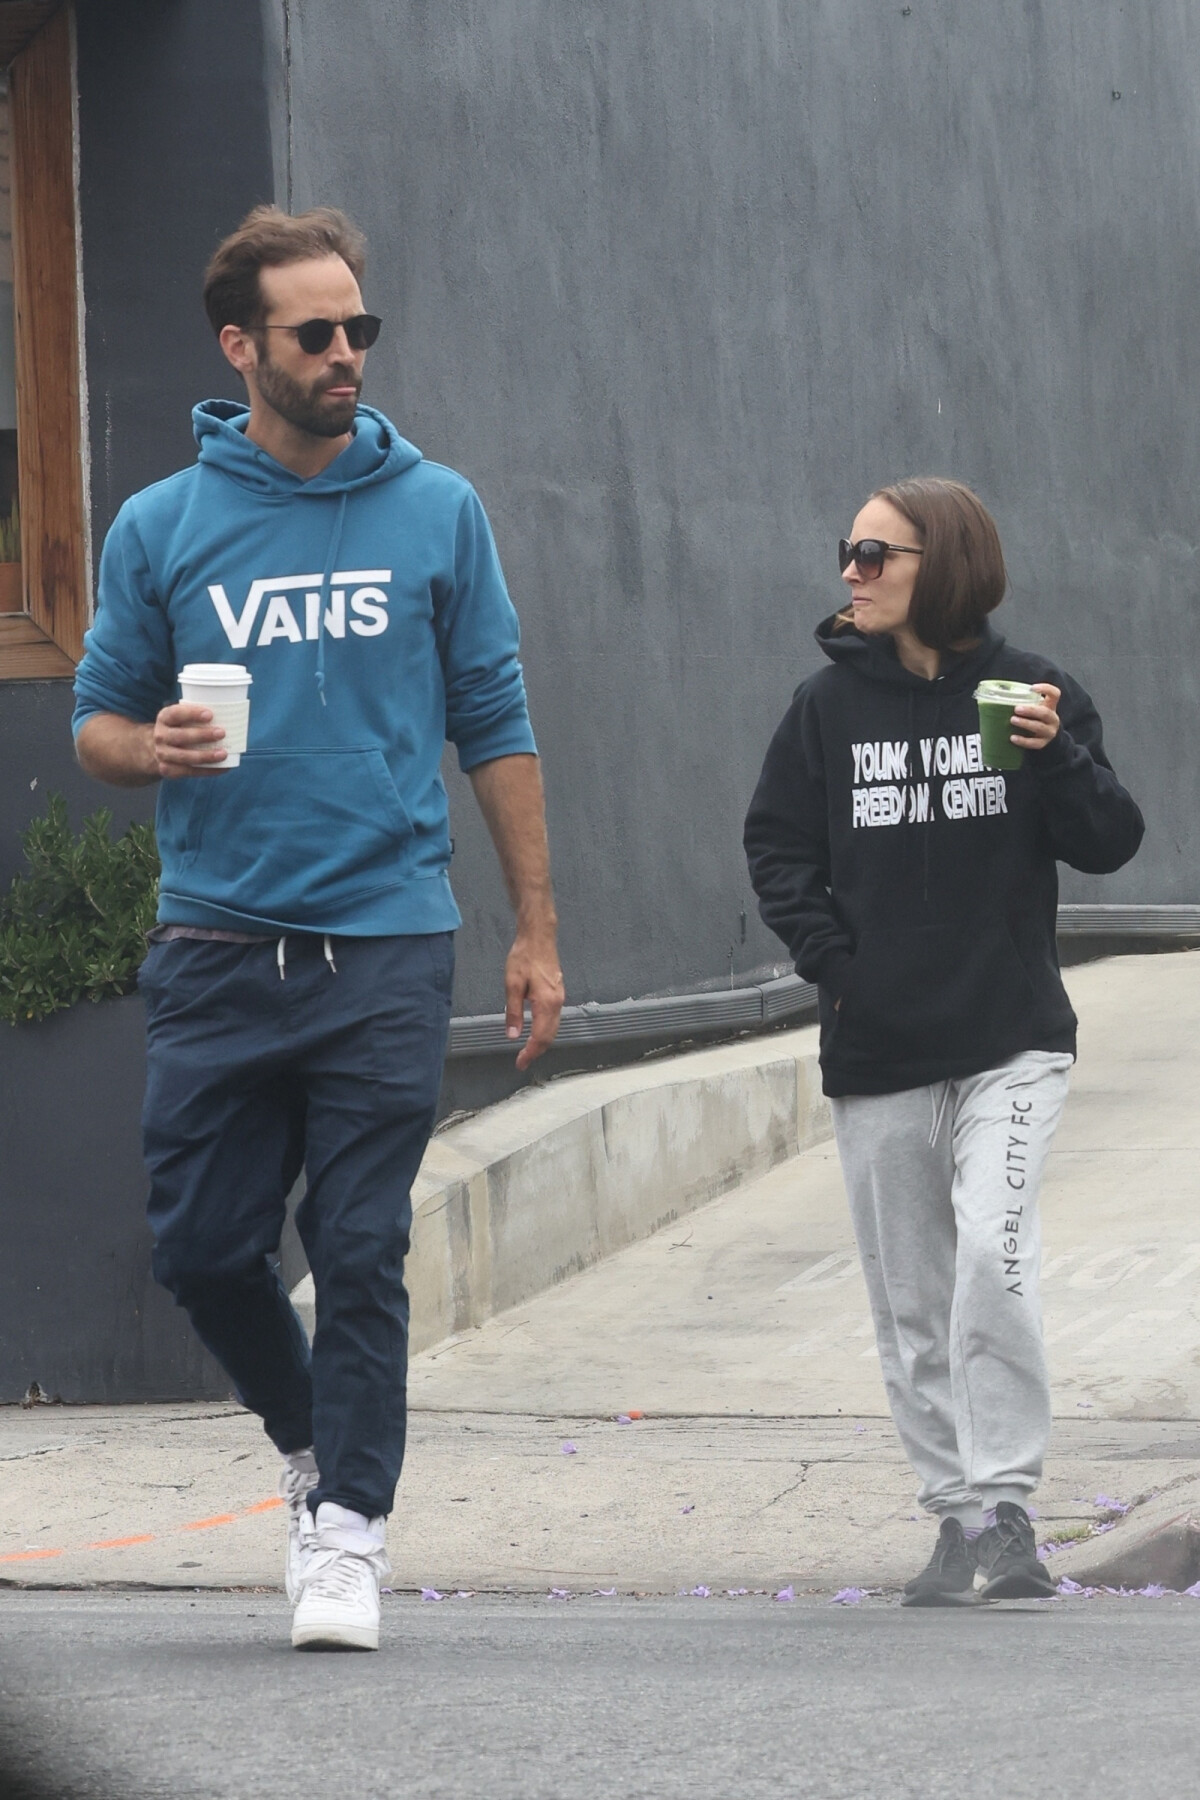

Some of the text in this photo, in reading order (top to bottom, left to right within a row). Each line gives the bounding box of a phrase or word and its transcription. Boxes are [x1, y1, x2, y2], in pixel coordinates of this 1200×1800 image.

[207, 569, 392, 649] VANS
[941, 775, 1009, 820] CENTER
[1004, 1100, 1033, 1297] ANGEL CITY FC
